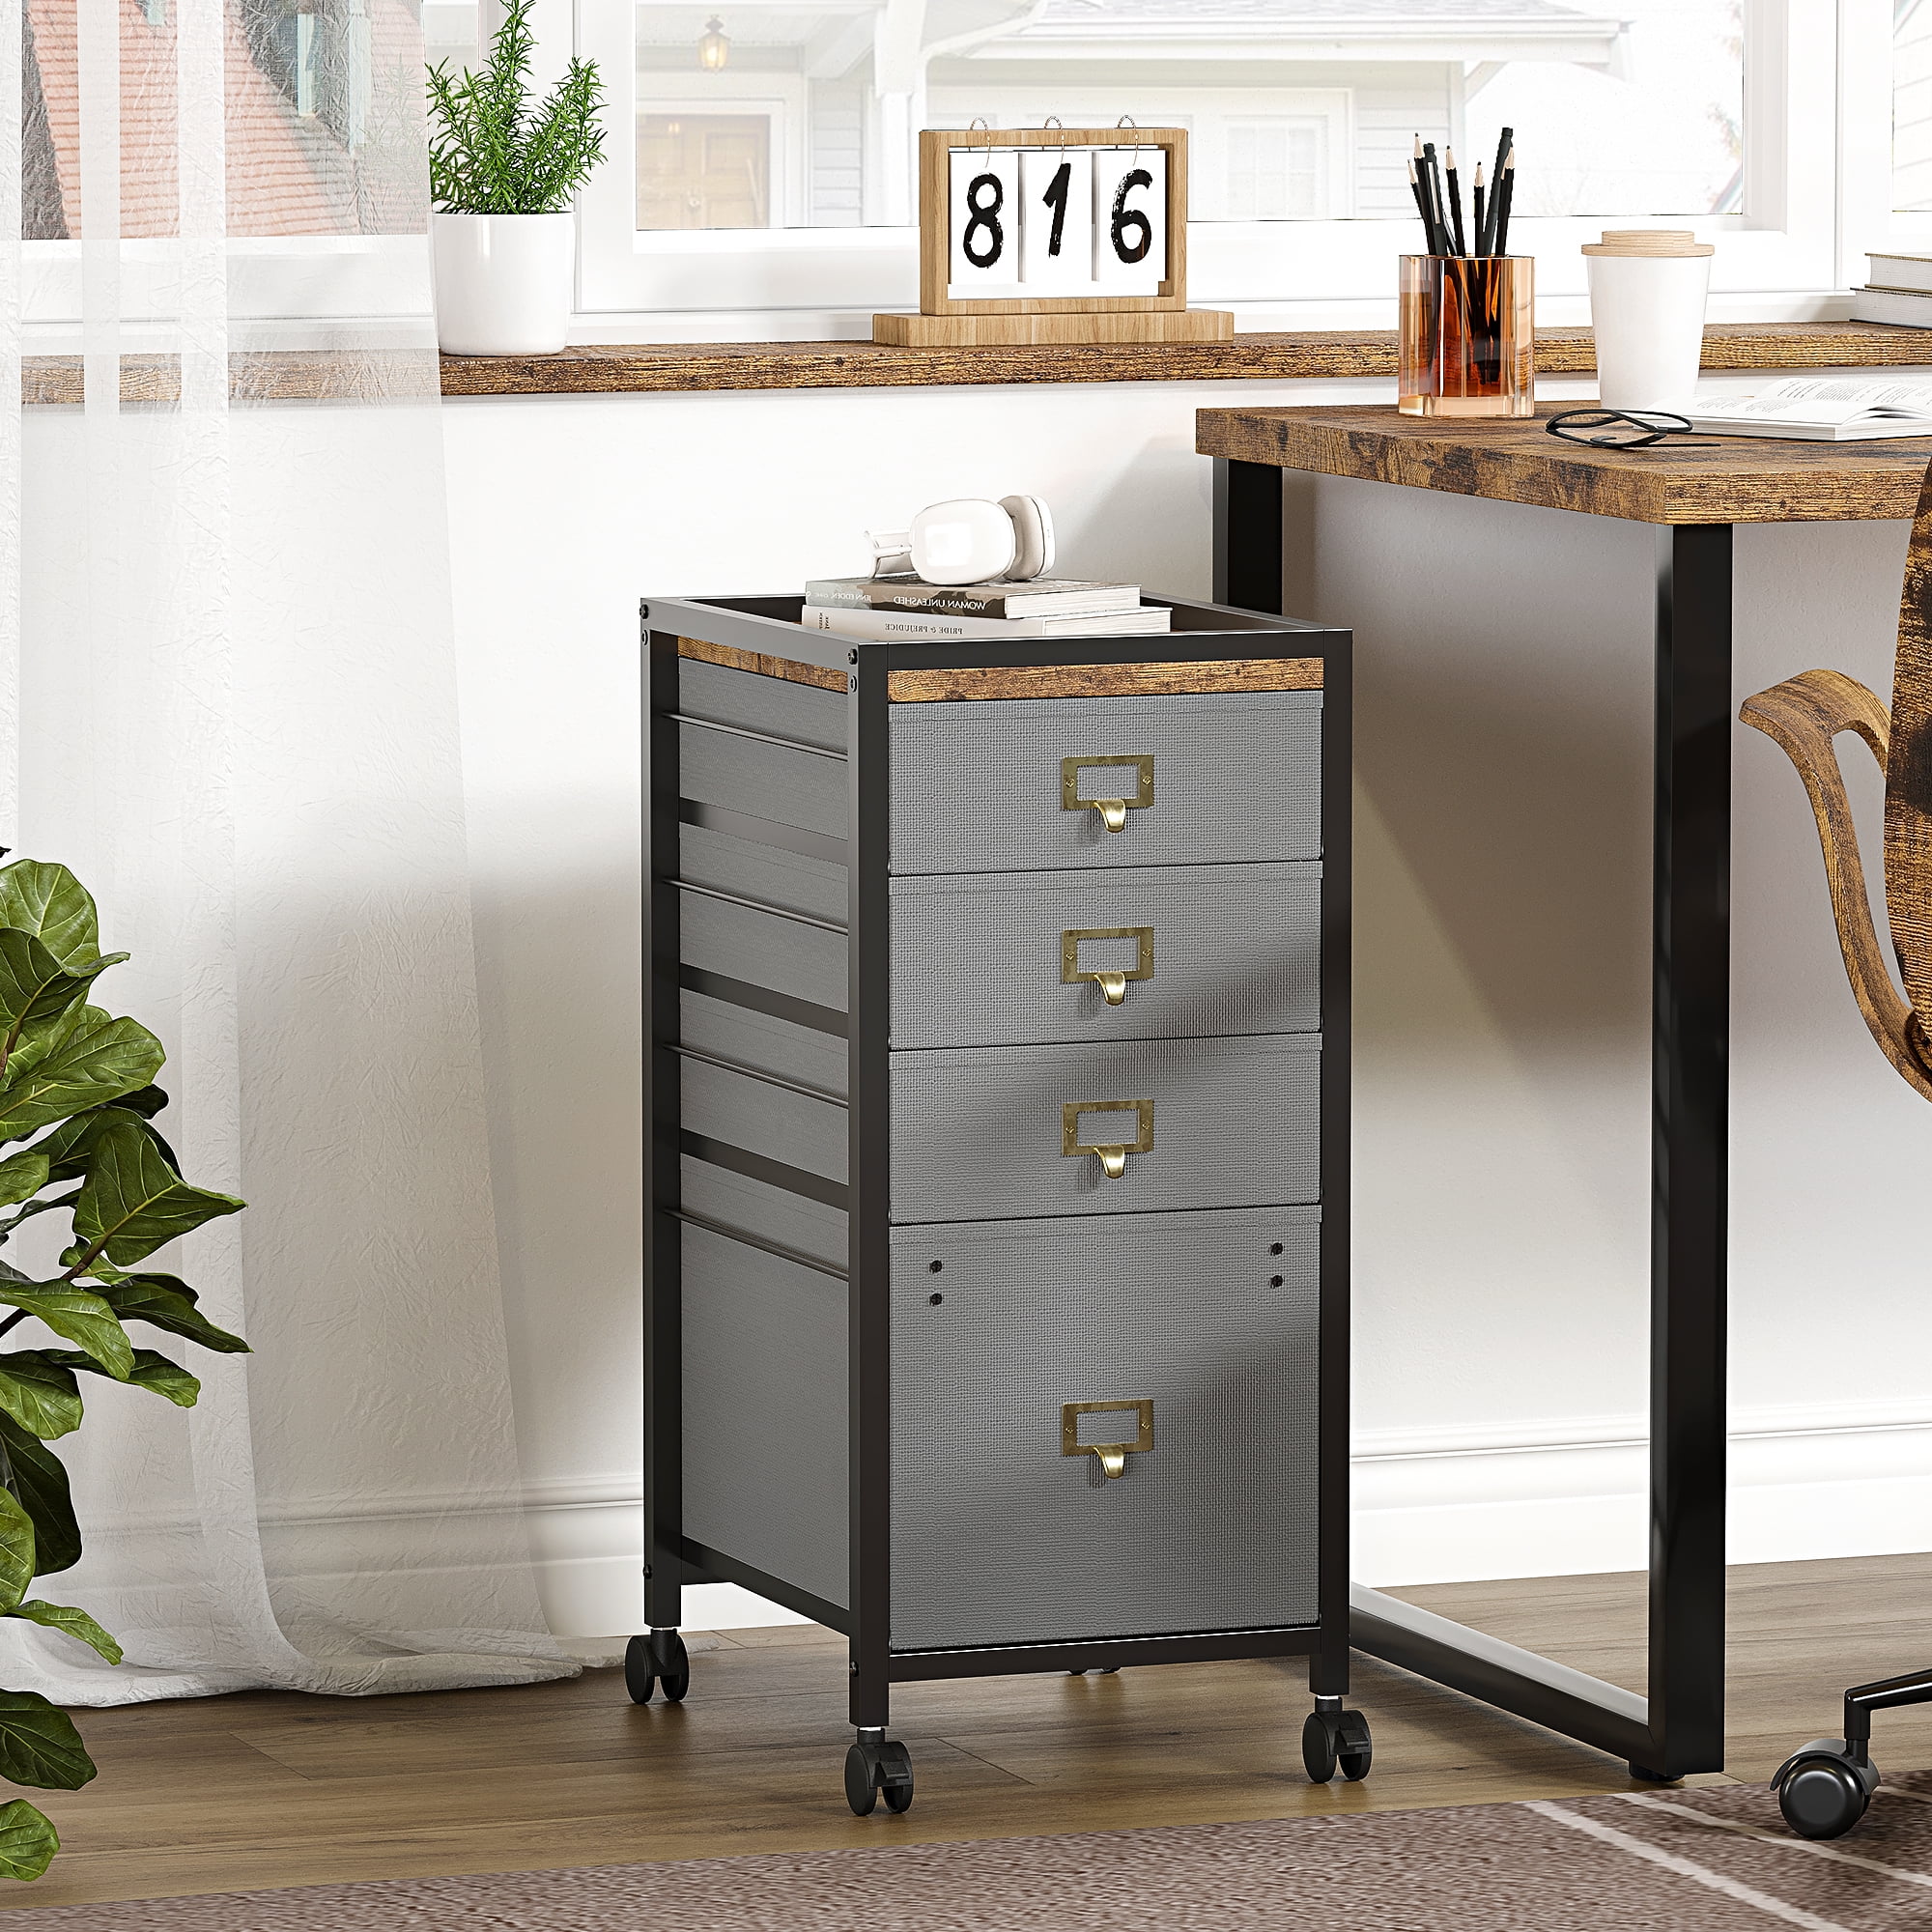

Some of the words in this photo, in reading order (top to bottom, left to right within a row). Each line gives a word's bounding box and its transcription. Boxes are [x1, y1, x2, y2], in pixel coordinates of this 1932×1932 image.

[963, 173, 1004, 269] 8
[1042, 162, 1071, 257] 1
[1111, 168, 1152, 264] 6
